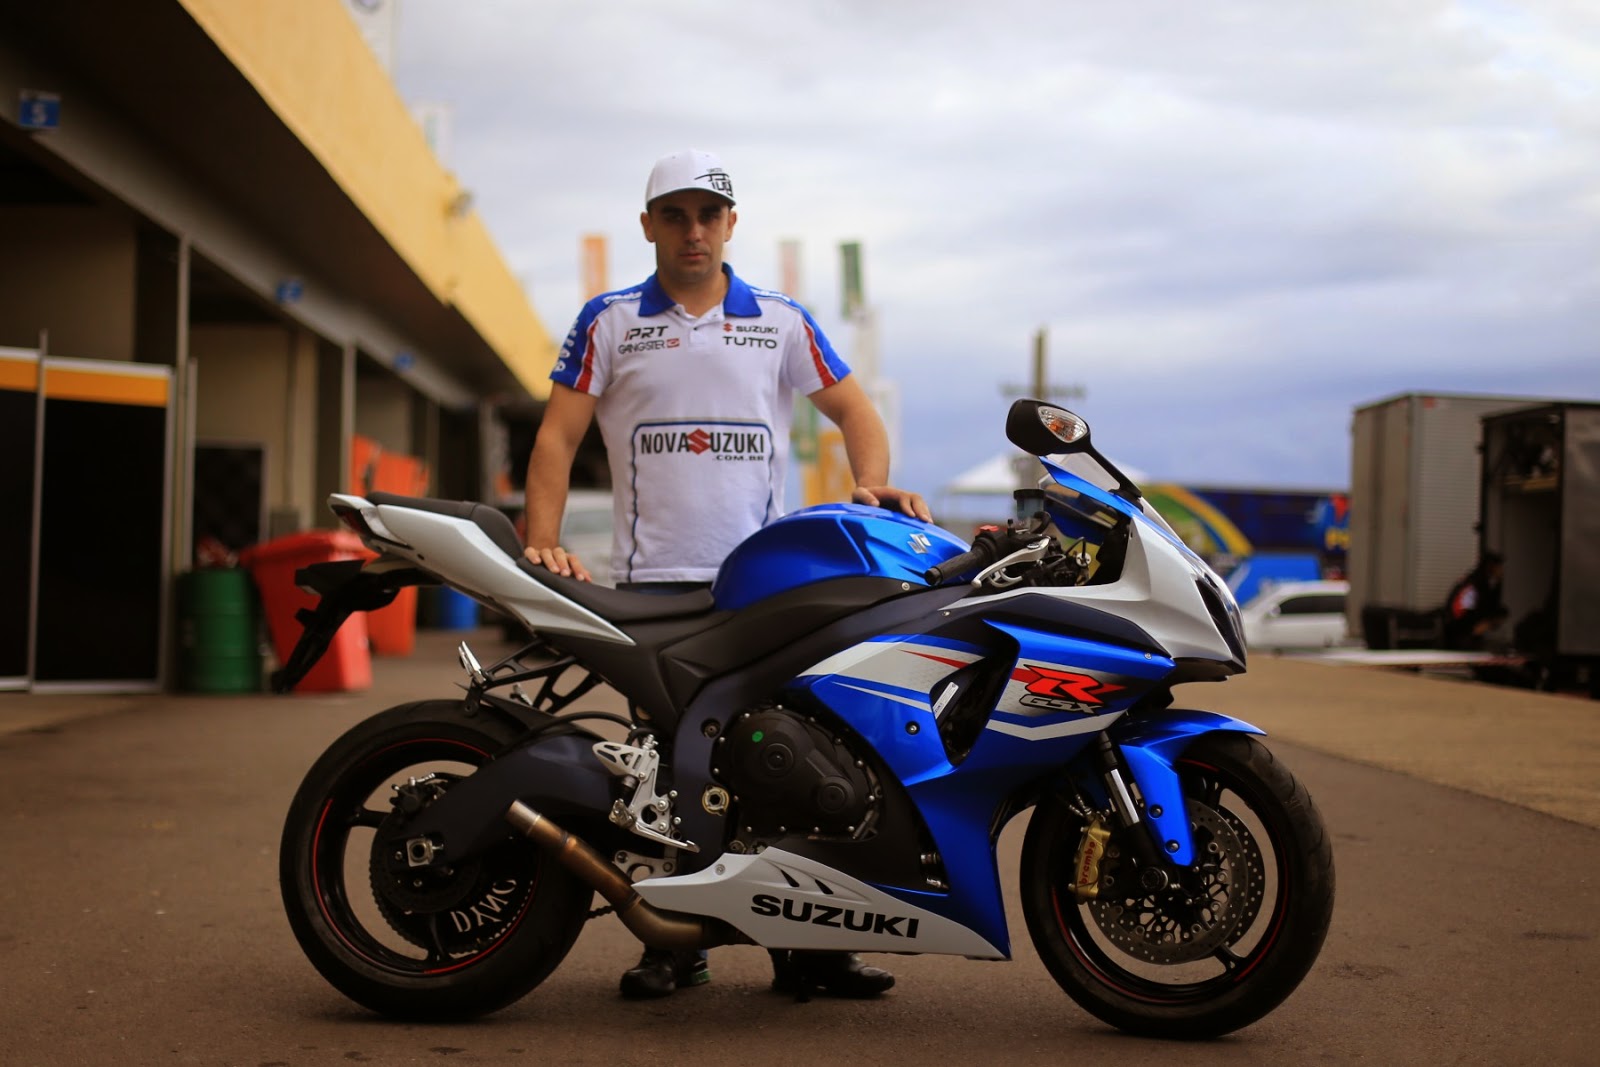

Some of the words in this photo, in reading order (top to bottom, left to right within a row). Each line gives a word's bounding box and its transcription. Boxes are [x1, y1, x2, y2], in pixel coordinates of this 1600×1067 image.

[735, 325, 779, 334] SUZUKI
[617, 340, 665, 355] GANGSTER
[722, 335, 777, 349] TUTTO
[1019, 694, 1104, 716] GSX
[1079, 841, 1096, 885] brembo
[751, 894, 919, 938] SUZUKI
